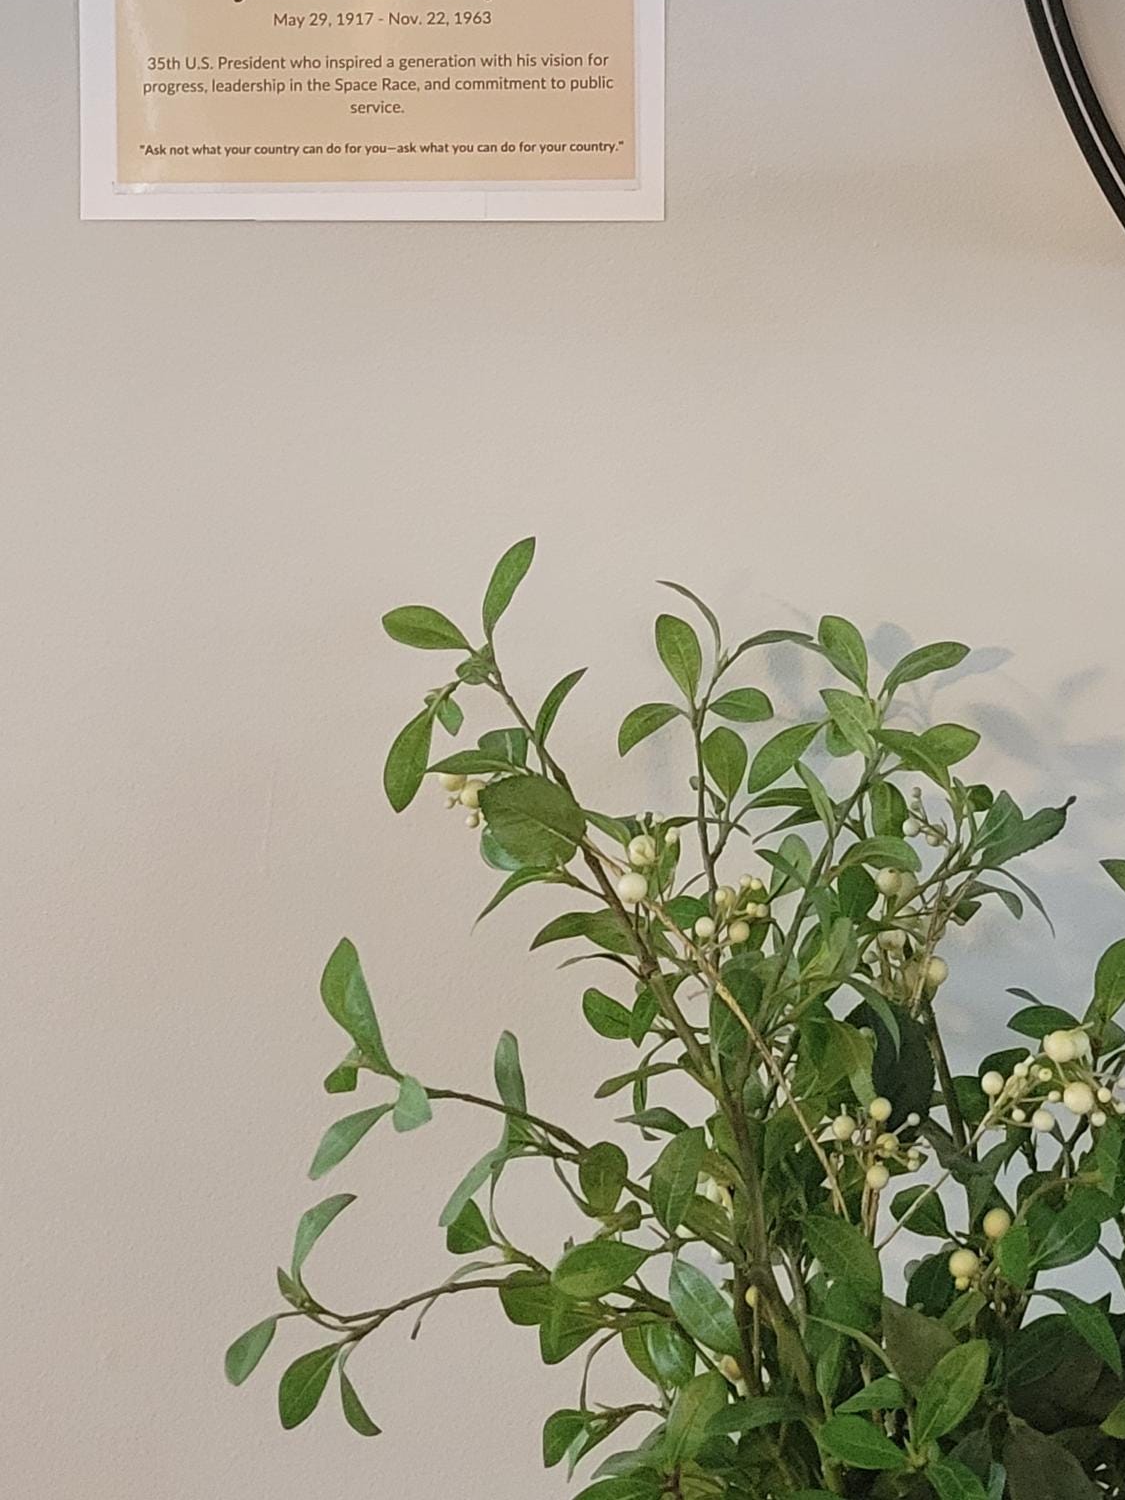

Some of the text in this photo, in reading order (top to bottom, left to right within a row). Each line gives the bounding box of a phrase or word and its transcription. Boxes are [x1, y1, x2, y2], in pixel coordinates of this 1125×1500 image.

[273, 12, 305, 30] May
[309, 12, 333, 29] 29,
[337, 11, 374, 27] 1917
[388, 11, 423, 28] Nov.
[427, 11, 450, 28] 22,
[454, 10, 492, 26] 1963
[147, 52, 610, 73] 35th U.S. President who inspired a generation with his vision for
[143, 74, 614, 97] progress, leadership in the Space Race, and commitment to public
[350, 100, 405, 114] service.
[139, 143, 168, 155] "Ask
[169, 143, 190, 155] not
[192, 142, 222, 155] what
[224, 145, 252, 158] your
[254, 142, 300, 158] country
[302, 145, 324, 154] can
[326, 141, 342, 154] do
[345, 141, 362, 154] for
[419, 141, 450, 153] what
[452, 143, 474, 156] you
[477, 143, 498, 153] can
[501, 140, 516, 152] do
[519, 140, 536, 152] for
[539, 143, 566, 156] your
